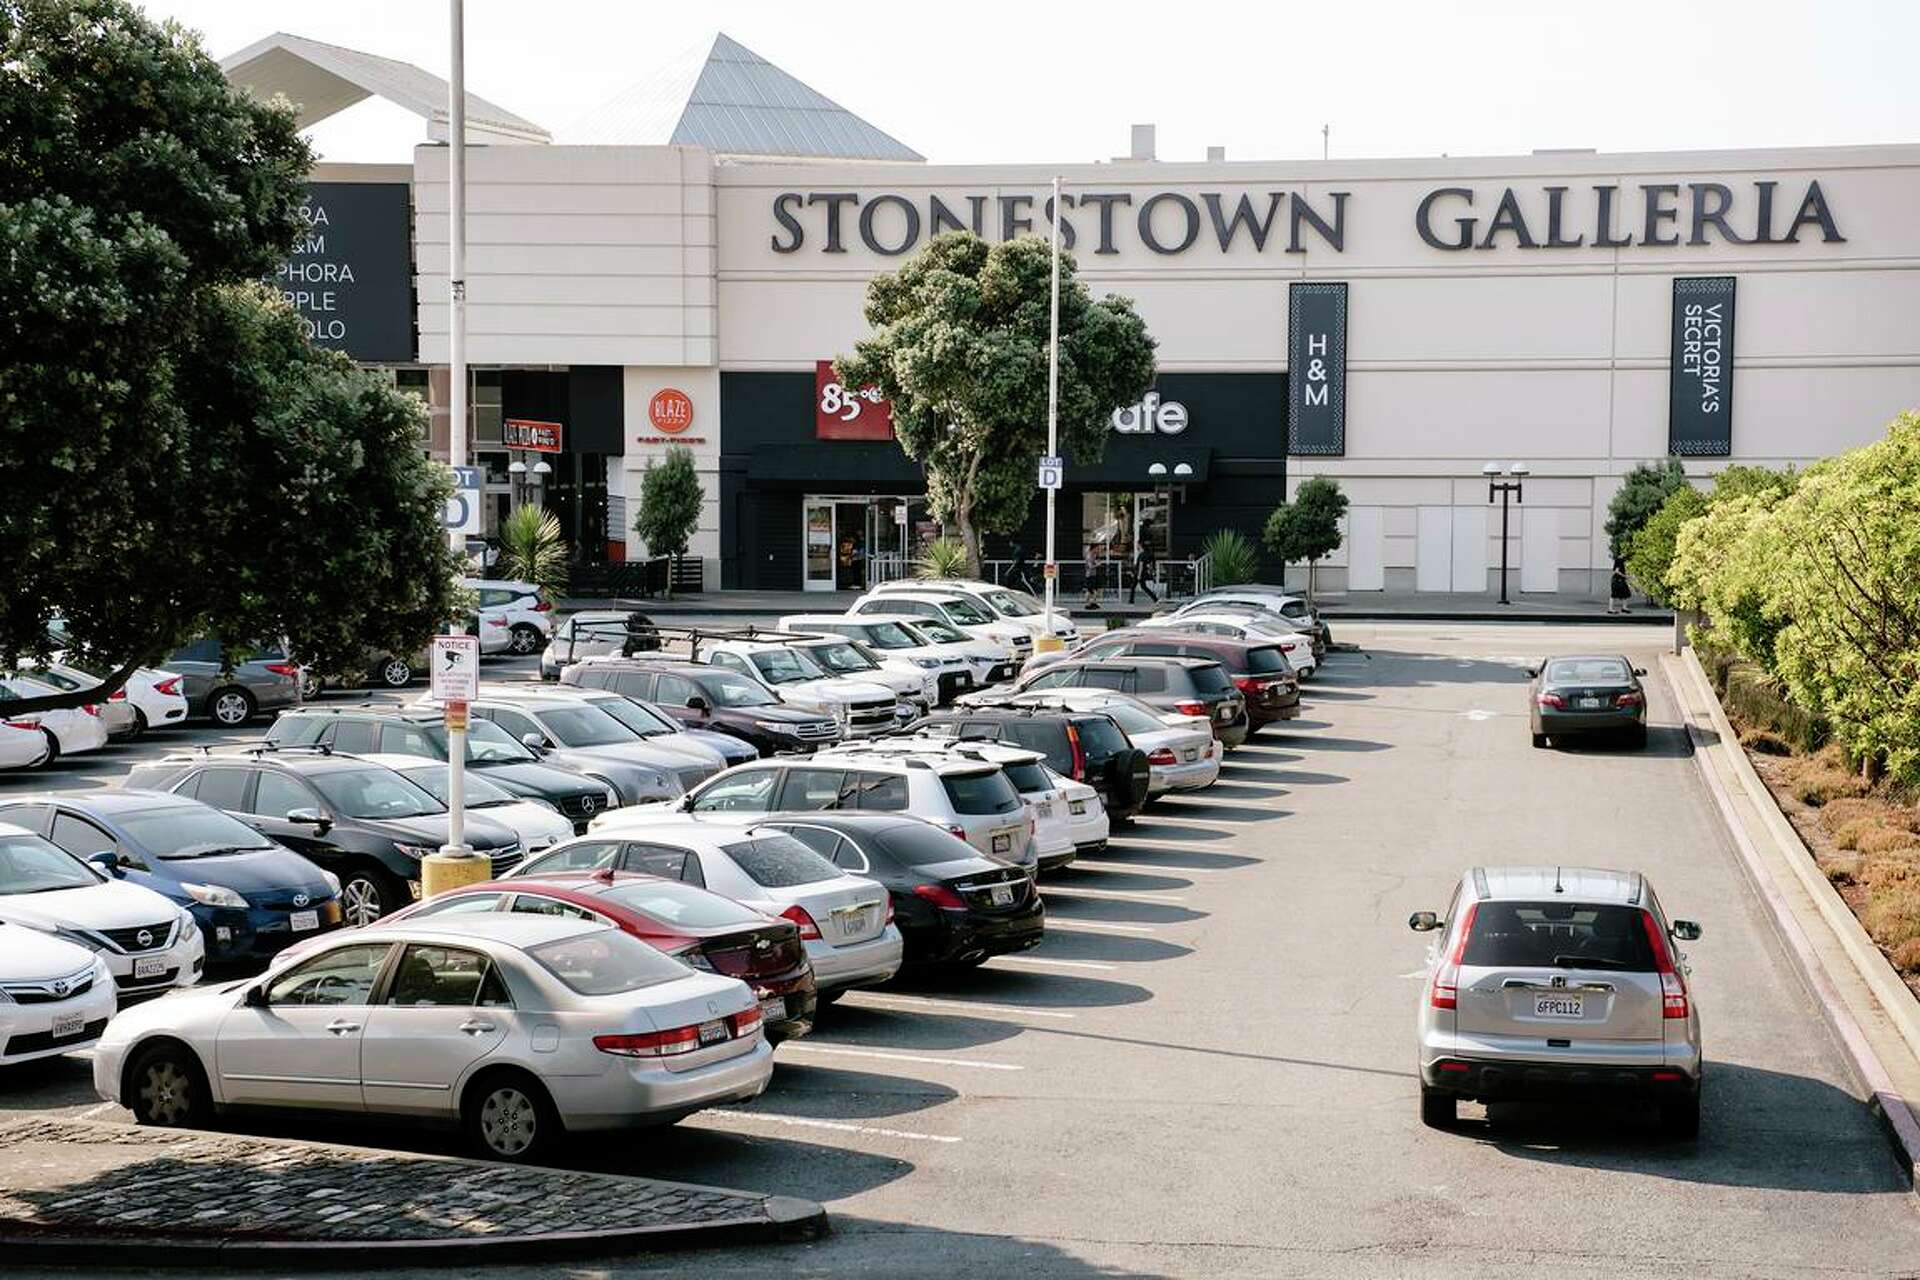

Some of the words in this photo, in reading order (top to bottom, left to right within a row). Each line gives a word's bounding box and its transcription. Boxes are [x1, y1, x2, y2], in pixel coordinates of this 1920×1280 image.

[298, 205, 330, 226] RA
[771, 190, 1351, 256] STONESTOWN
[1415, 179, 1847, 251] GALLERIA
[291, 234, 325, 254] &M
[276, 262, 355, 283] PHORA
[282, 290, 336, 311] PPLE
[1683, 303, 1703, 377] SECRET
[1702, 303, 1722, 414] VICTORIA'S
[1305, 333, 1328, 406] H&M
[655, 399, 687, 418] BLAZE
[1112, 391, 1189, 434] afe
[1041, 457, 1062, 466] LOT
[447, 470, 473, 486] OT
[1043, 469, 1057, 486] D
[441, 496, 469, 528] D
[438, 641, 471, 650] NOTICE
[1537, 1001, 1581, 1014] 6FPC112
